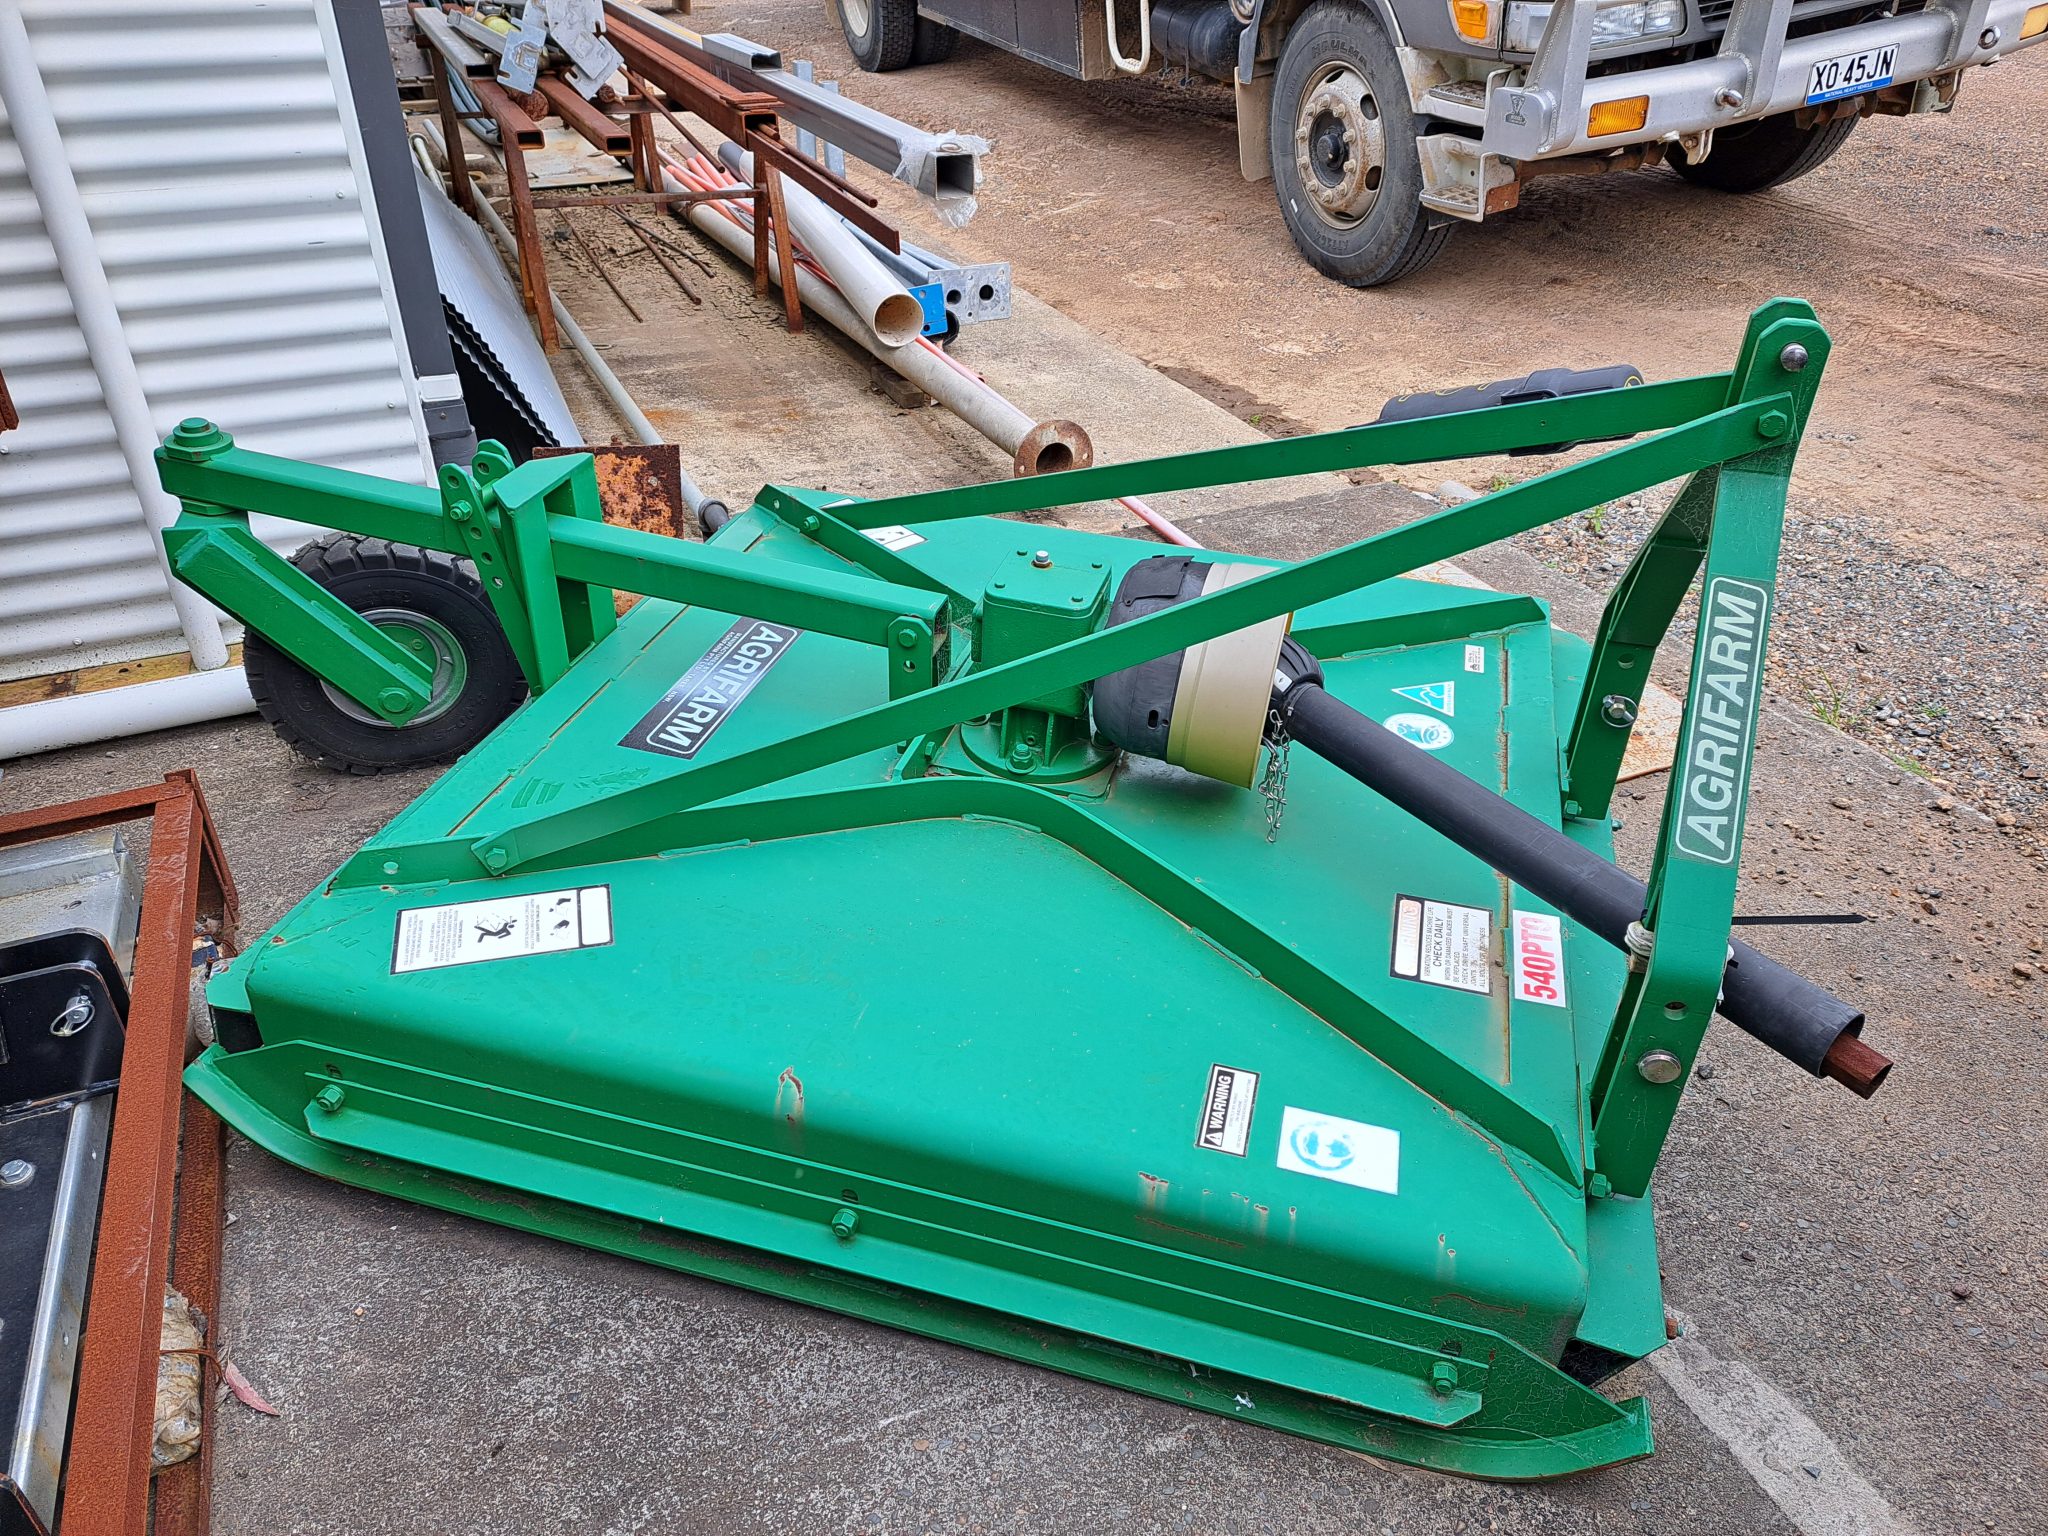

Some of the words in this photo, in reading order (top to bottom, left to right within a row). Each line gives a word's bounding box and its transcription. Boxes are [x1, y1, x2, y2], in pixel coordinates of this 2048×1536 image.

[1844, 86, 1857, 94] HEAVY
[659, 626, 784, 746] AGRIFARM
[1687, 592, 1757, 852] AGRIFARM
[1434, 917, 1443, 938] DAILY
[1433, 940, 1442, 966] CHECK
[1209, 1075, 1232, 1129] WARNING
